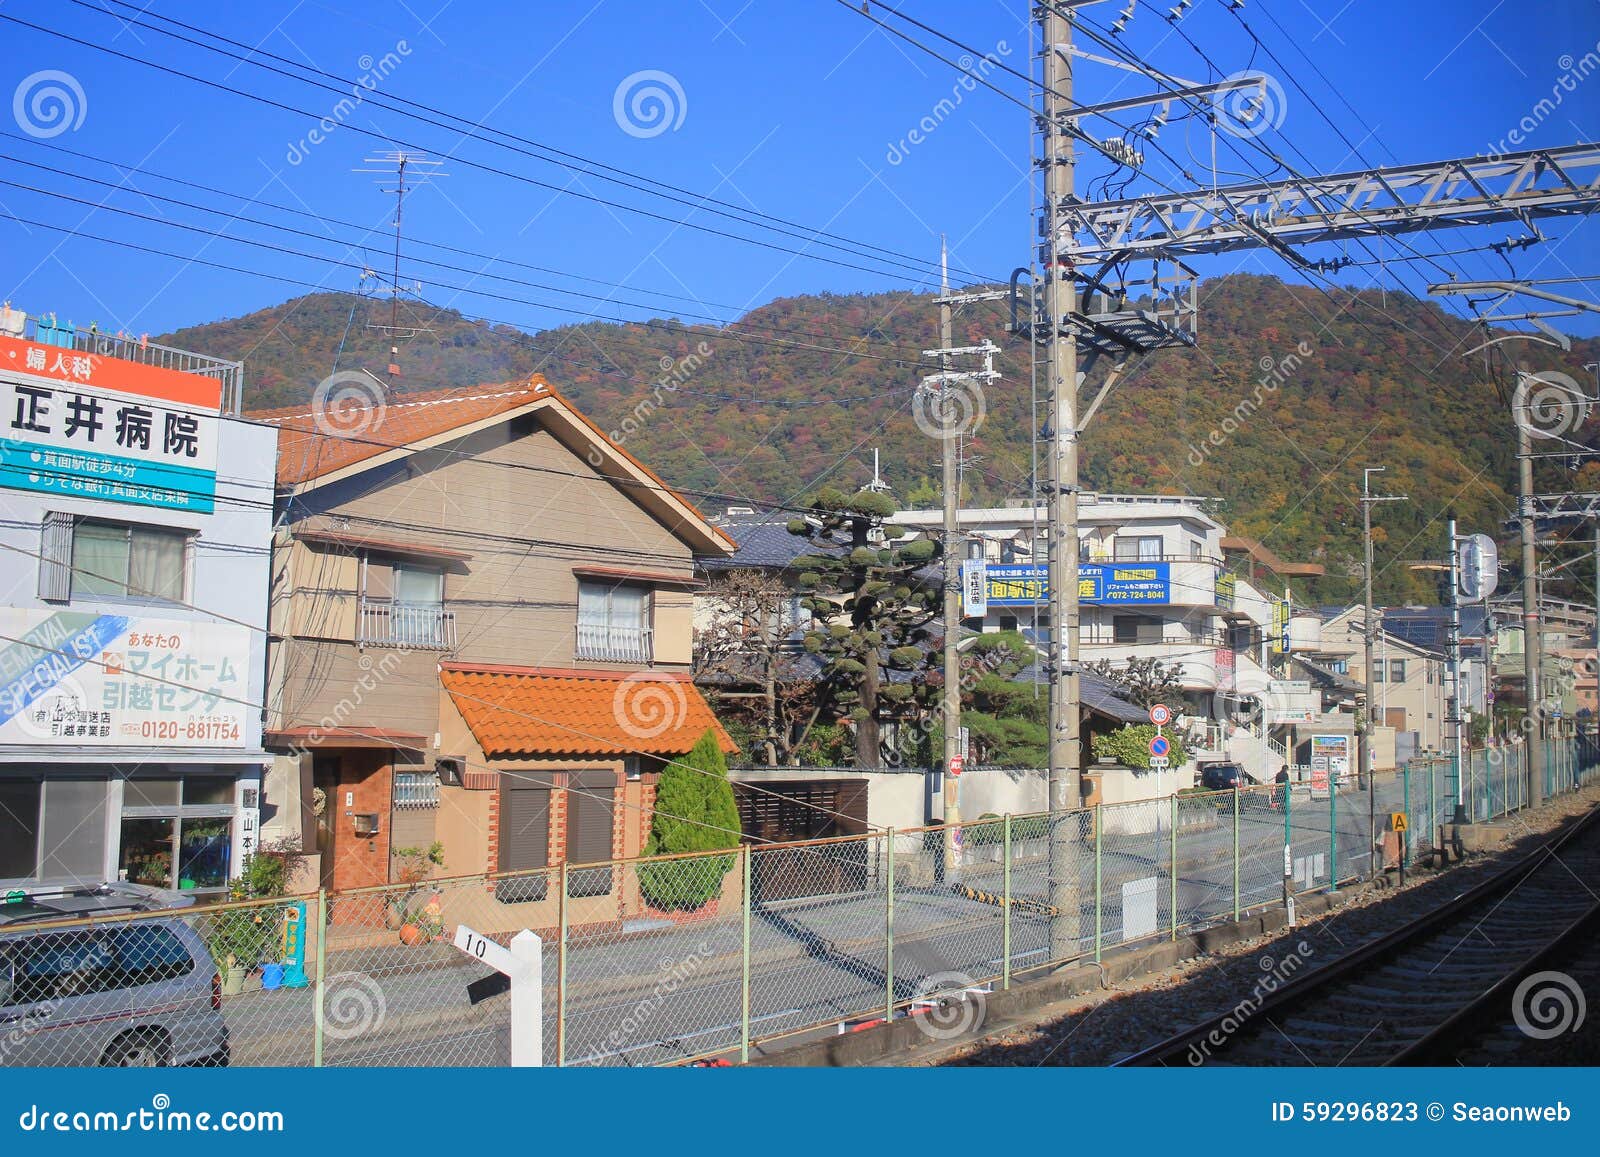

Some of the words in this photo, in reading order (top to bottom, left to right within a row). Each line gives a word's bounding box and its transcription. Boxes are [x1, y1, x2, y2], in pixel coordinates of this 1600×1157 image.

[11, 386, 198, 457] 正井病院
[129, 632, 180, 649] あなたの
[0, 623, 101, 716] SPECIALIST
[128, 651, 237, 682] マイホーム
[103, 681, 242, 713] 引越センター
[52, 723, 110, 737] 引越事業部
[142, 721, 239, 740] 0120-881754
[1395, 815, 1405, 829] A
[466, 934, 486, 958] 10
